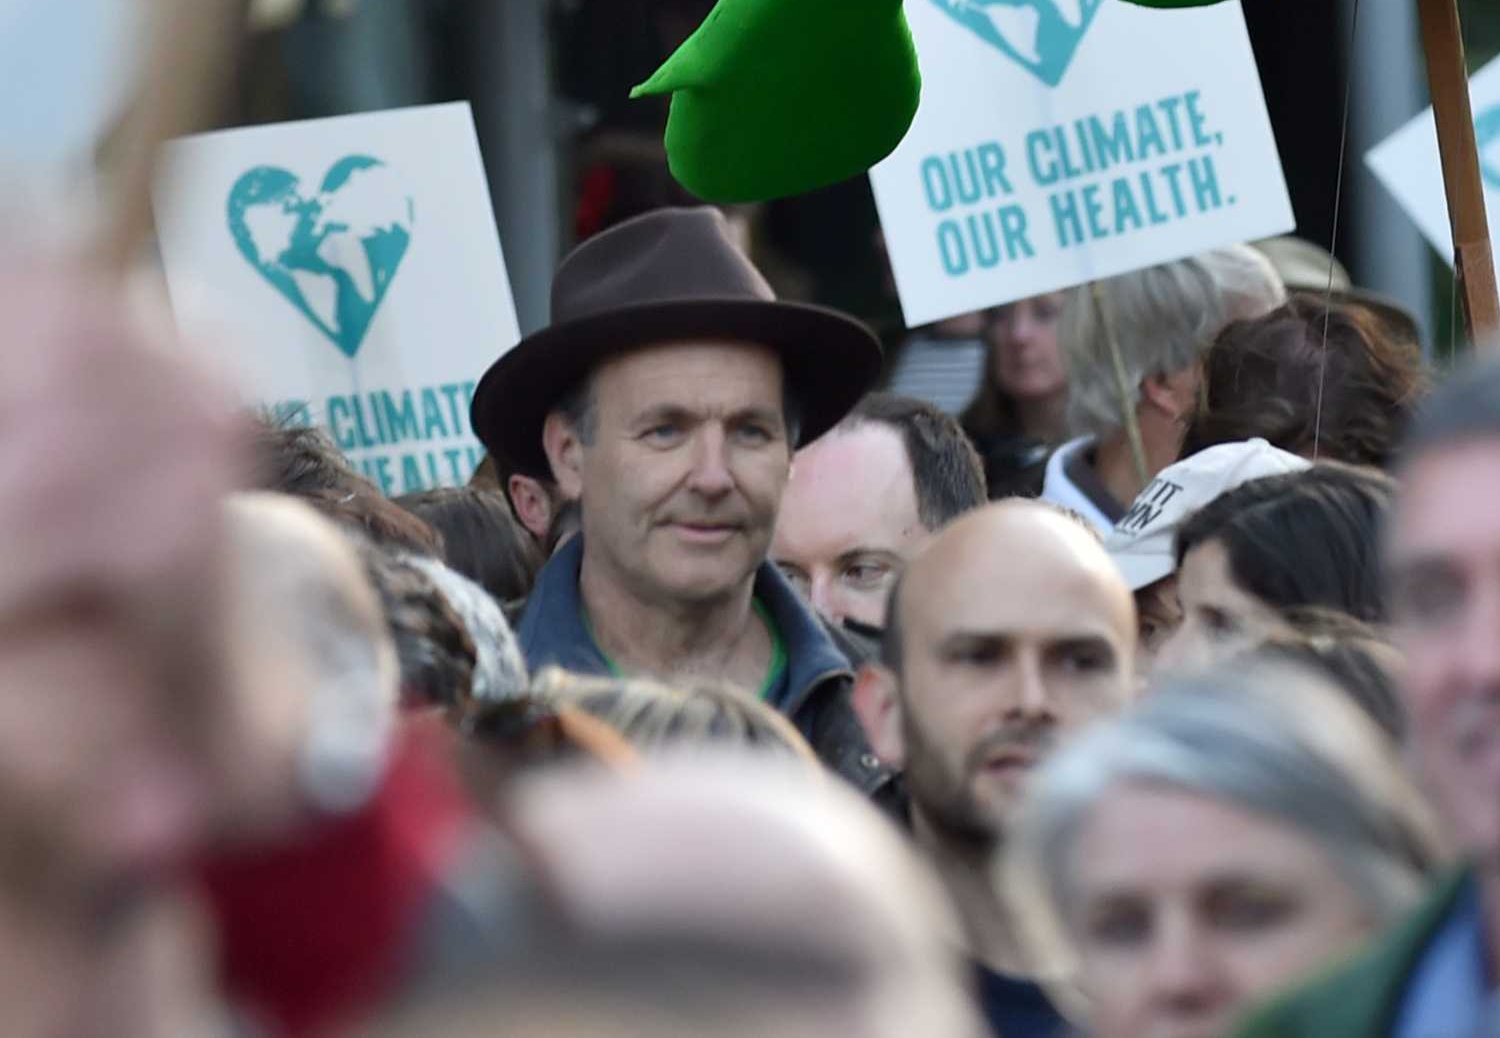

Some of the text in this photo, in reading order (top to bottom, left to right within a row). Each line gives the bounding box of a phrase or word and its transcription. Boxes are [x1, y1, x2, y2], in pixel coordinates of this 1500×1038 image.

[920, 89, 1225, 214] OUR CLIMATE,
[936, 154, 1238, 278] OUR HEALTH.
